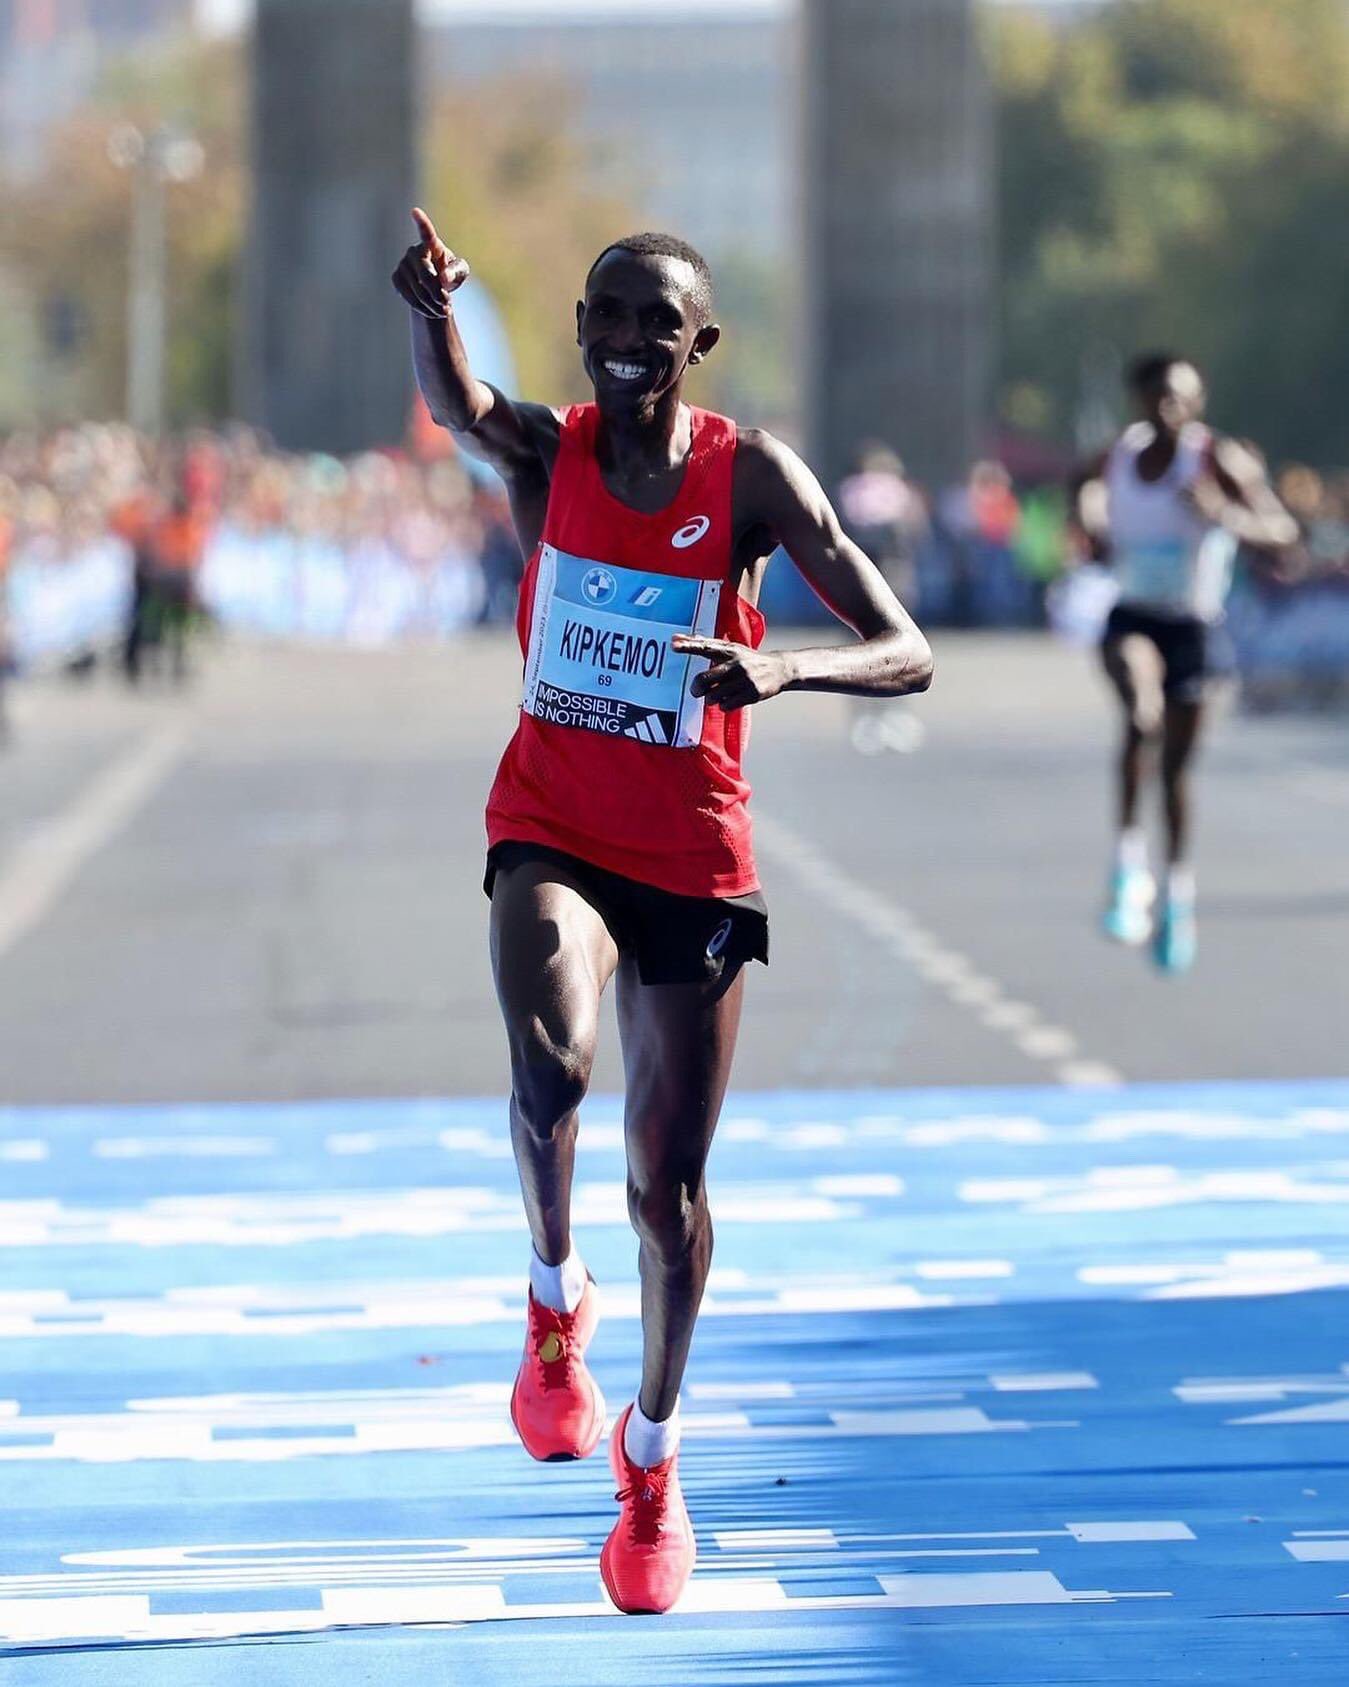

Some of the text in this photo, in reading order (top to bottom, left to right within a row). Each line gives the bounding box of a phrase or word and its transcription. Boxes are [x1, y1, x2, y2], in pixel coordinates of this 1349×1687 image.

[531, 638, 543, 682] September
[538, 616, 547, 638] 2023
[559, 619, 667, 679] KIPKEMOI
[597, 673, 613, 687] 69
[534, 701, 621, 733] IS NOTHING
[537, 683, 628, 718] IMPOSSIBLE
